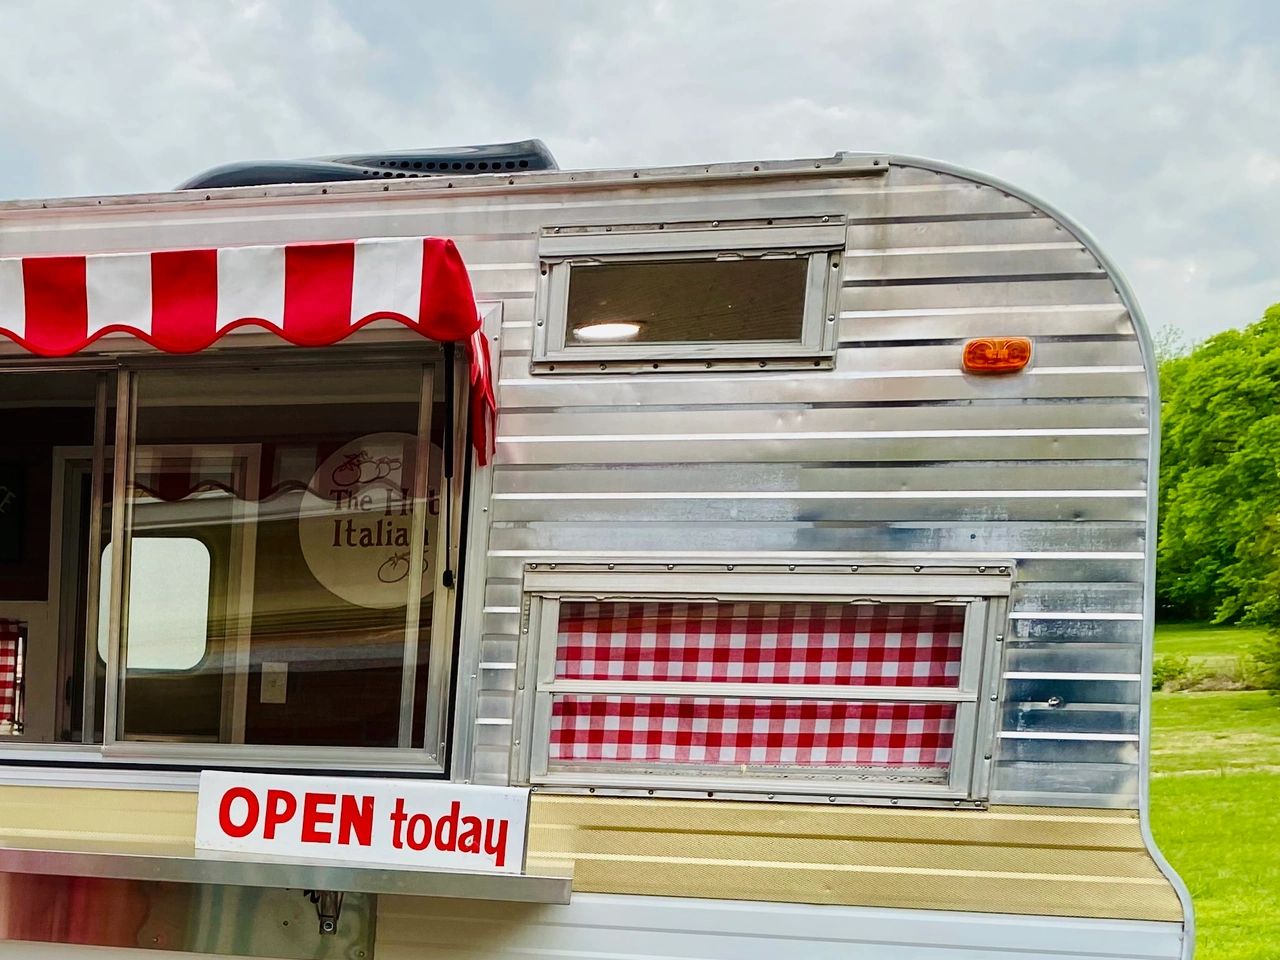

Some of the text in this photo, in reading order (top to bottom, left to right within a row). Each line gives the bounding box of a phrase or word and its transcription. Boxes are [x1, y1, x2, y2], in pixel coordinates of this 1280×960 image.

[329, 487, 440, 517] The Ht
[218, 786, 510, 868] OPEN today
